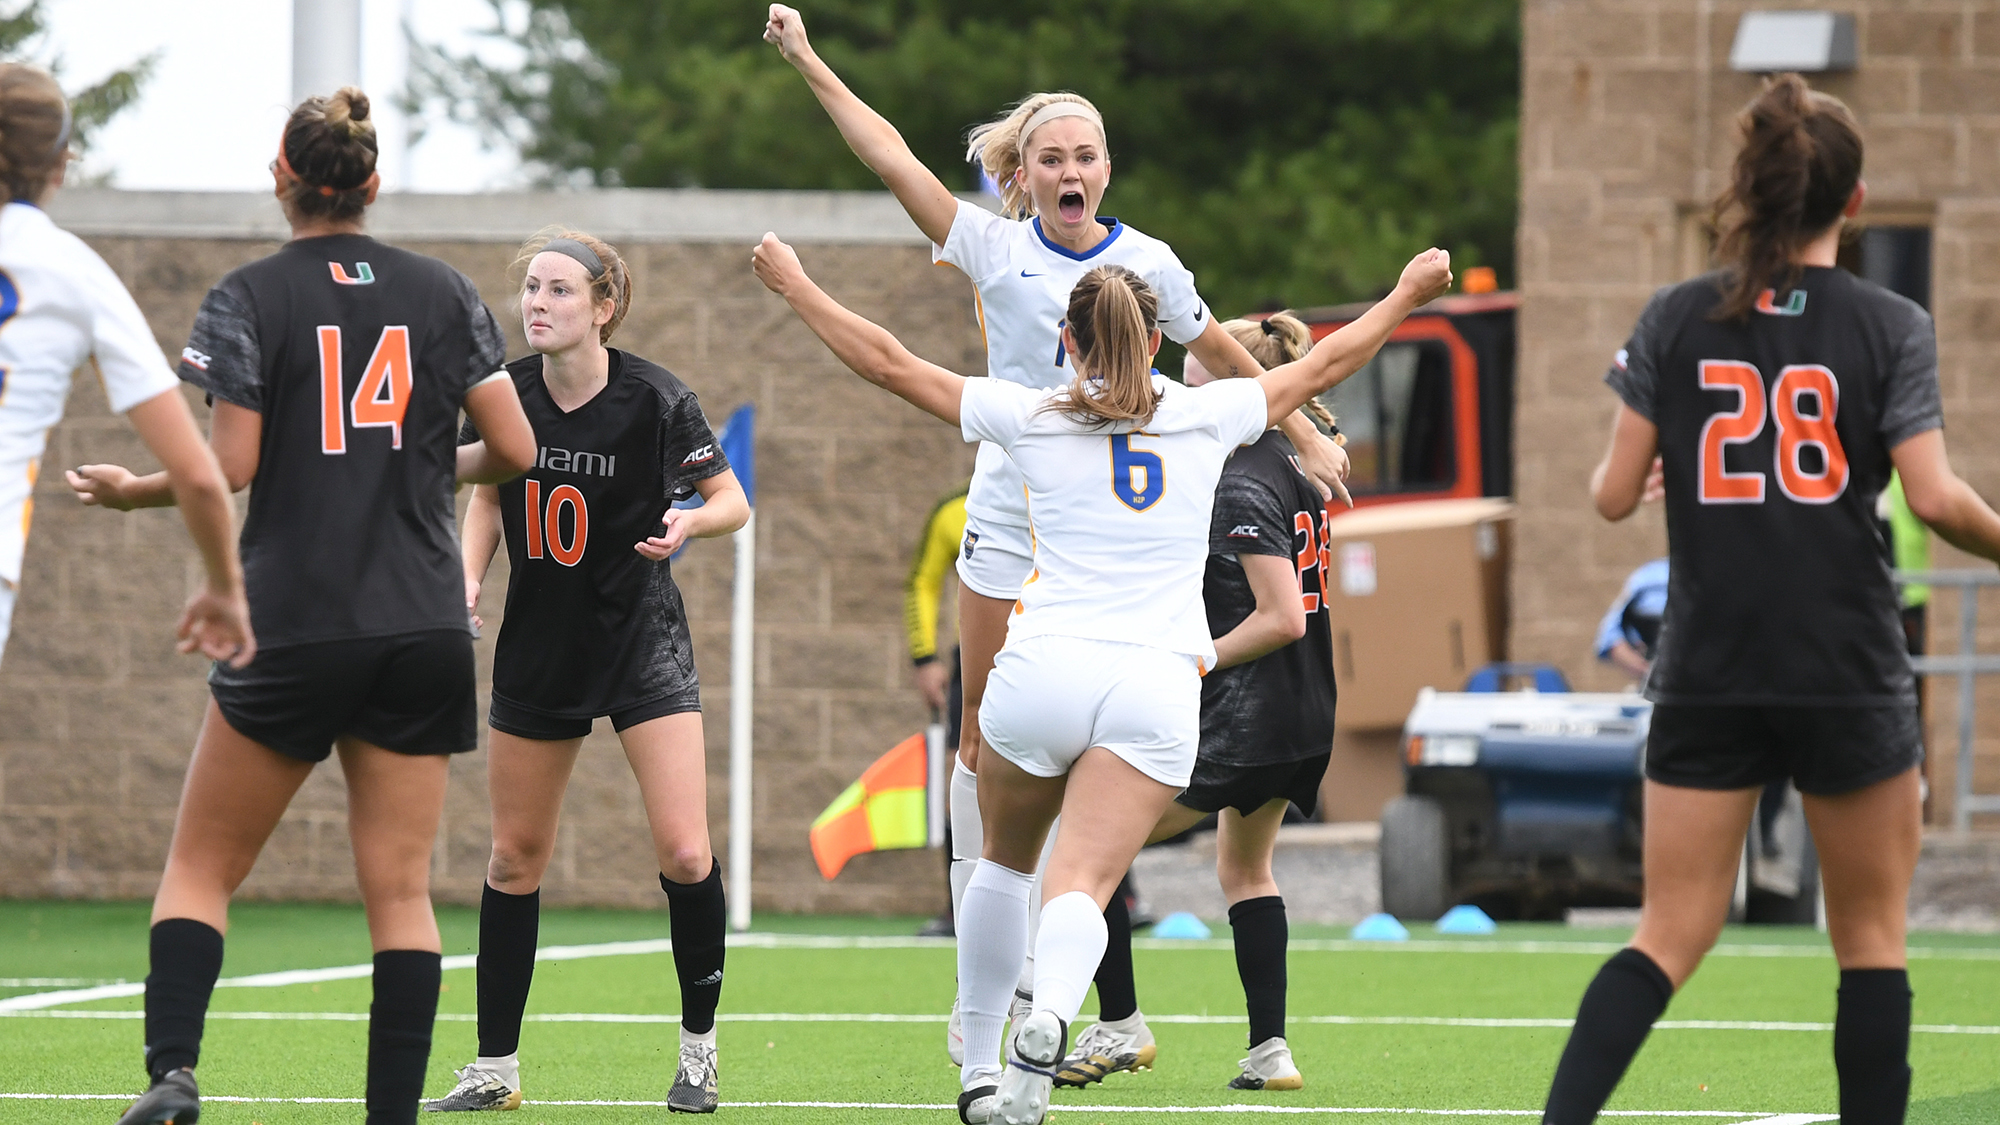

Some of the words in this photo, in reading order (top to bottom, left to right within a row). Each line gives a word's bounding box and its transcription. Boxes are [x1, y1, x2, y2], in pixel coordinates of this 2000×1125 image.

[316, 325, 413, 455] 14
[1697, 359, 1850, 504] 28
[531, 446, 615, 477] iami
[682, 444, 714, 464] ACC
[1108, 428, 1167, 514] 6
[525, 478, 588, 567] 10
[1229, 525, 1259, 537] ACC
